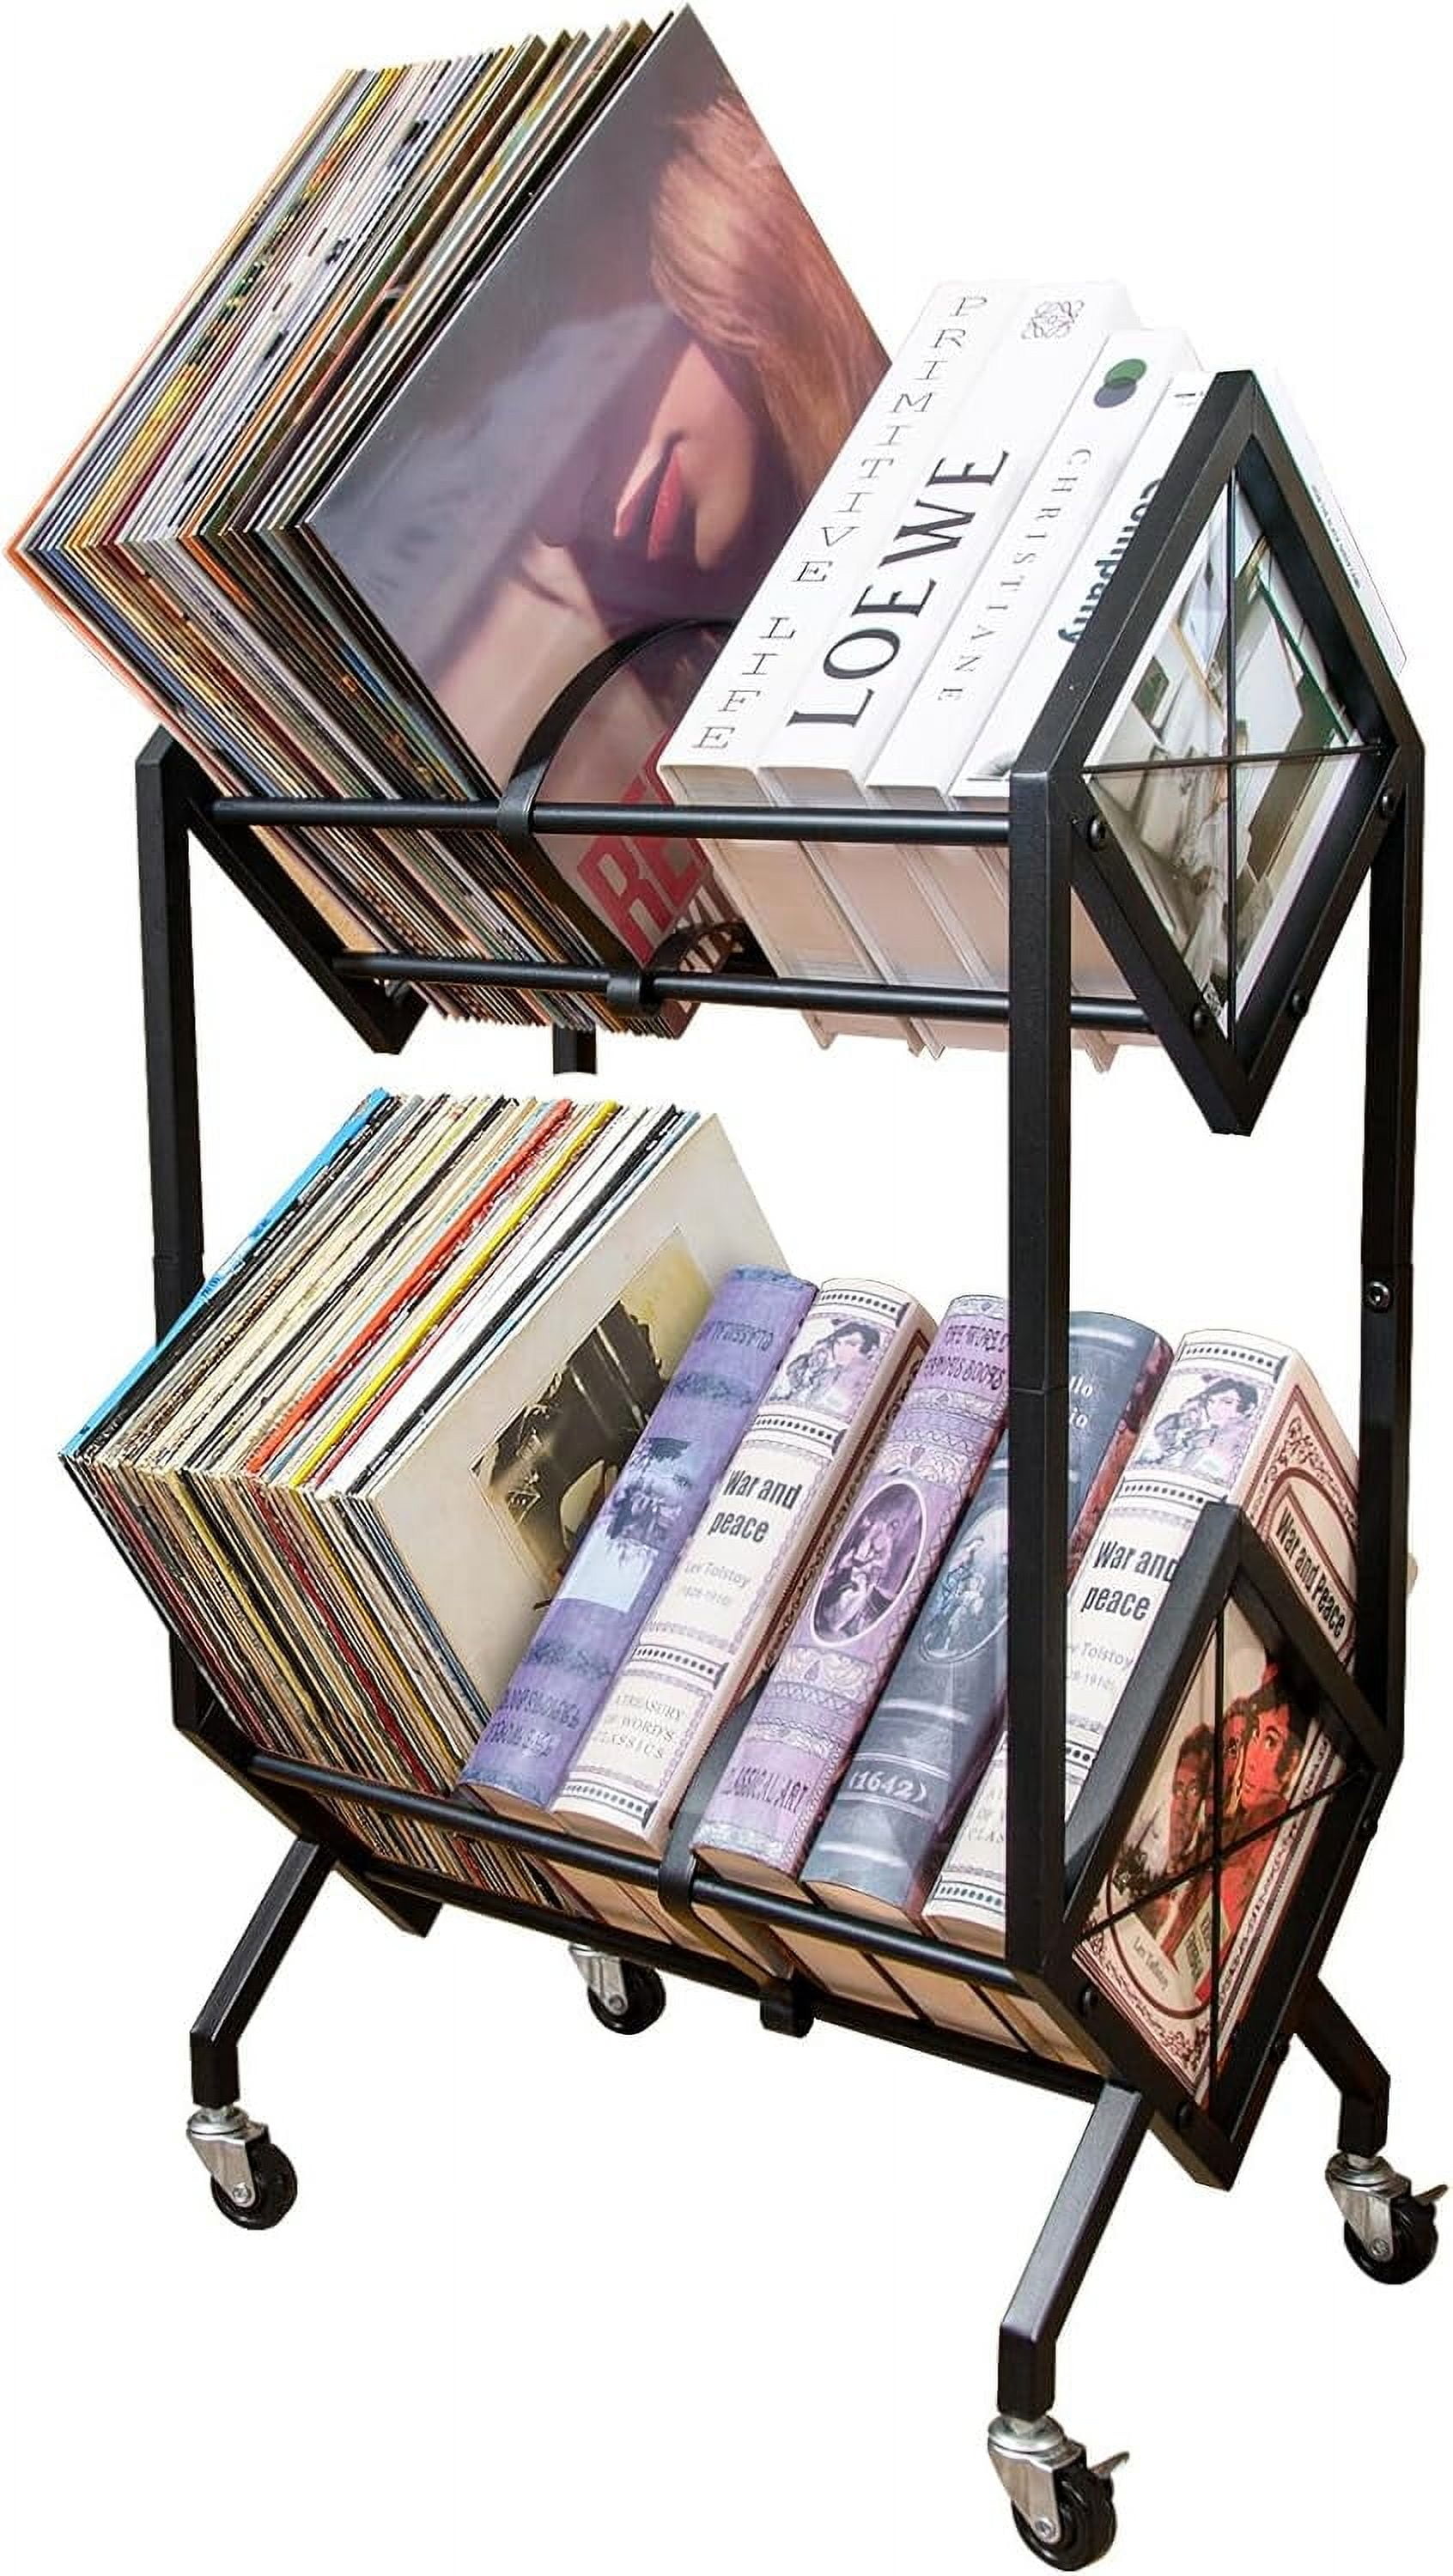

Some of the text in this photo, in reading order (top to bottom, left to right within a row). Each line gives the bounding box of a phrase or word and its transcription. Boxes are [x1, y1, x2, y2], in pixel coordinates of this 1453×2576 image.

[692, 295, 988, 750] PRIMITIVE LIFE
[787, 449, 1010, 728] LOEWE
[937, 447, 1091, 703] CHRISTIANE
[722, 1468, 803, 1510] War and
[707, 1510, 770, 1544] peace
[1092, 1539, 1133, 1571] War
[1275, 1509, 1347, 1638] War and Peace
[1080, 1583, 1151, 1621] peace
[848, 1770, 927, 1803] (1642)
